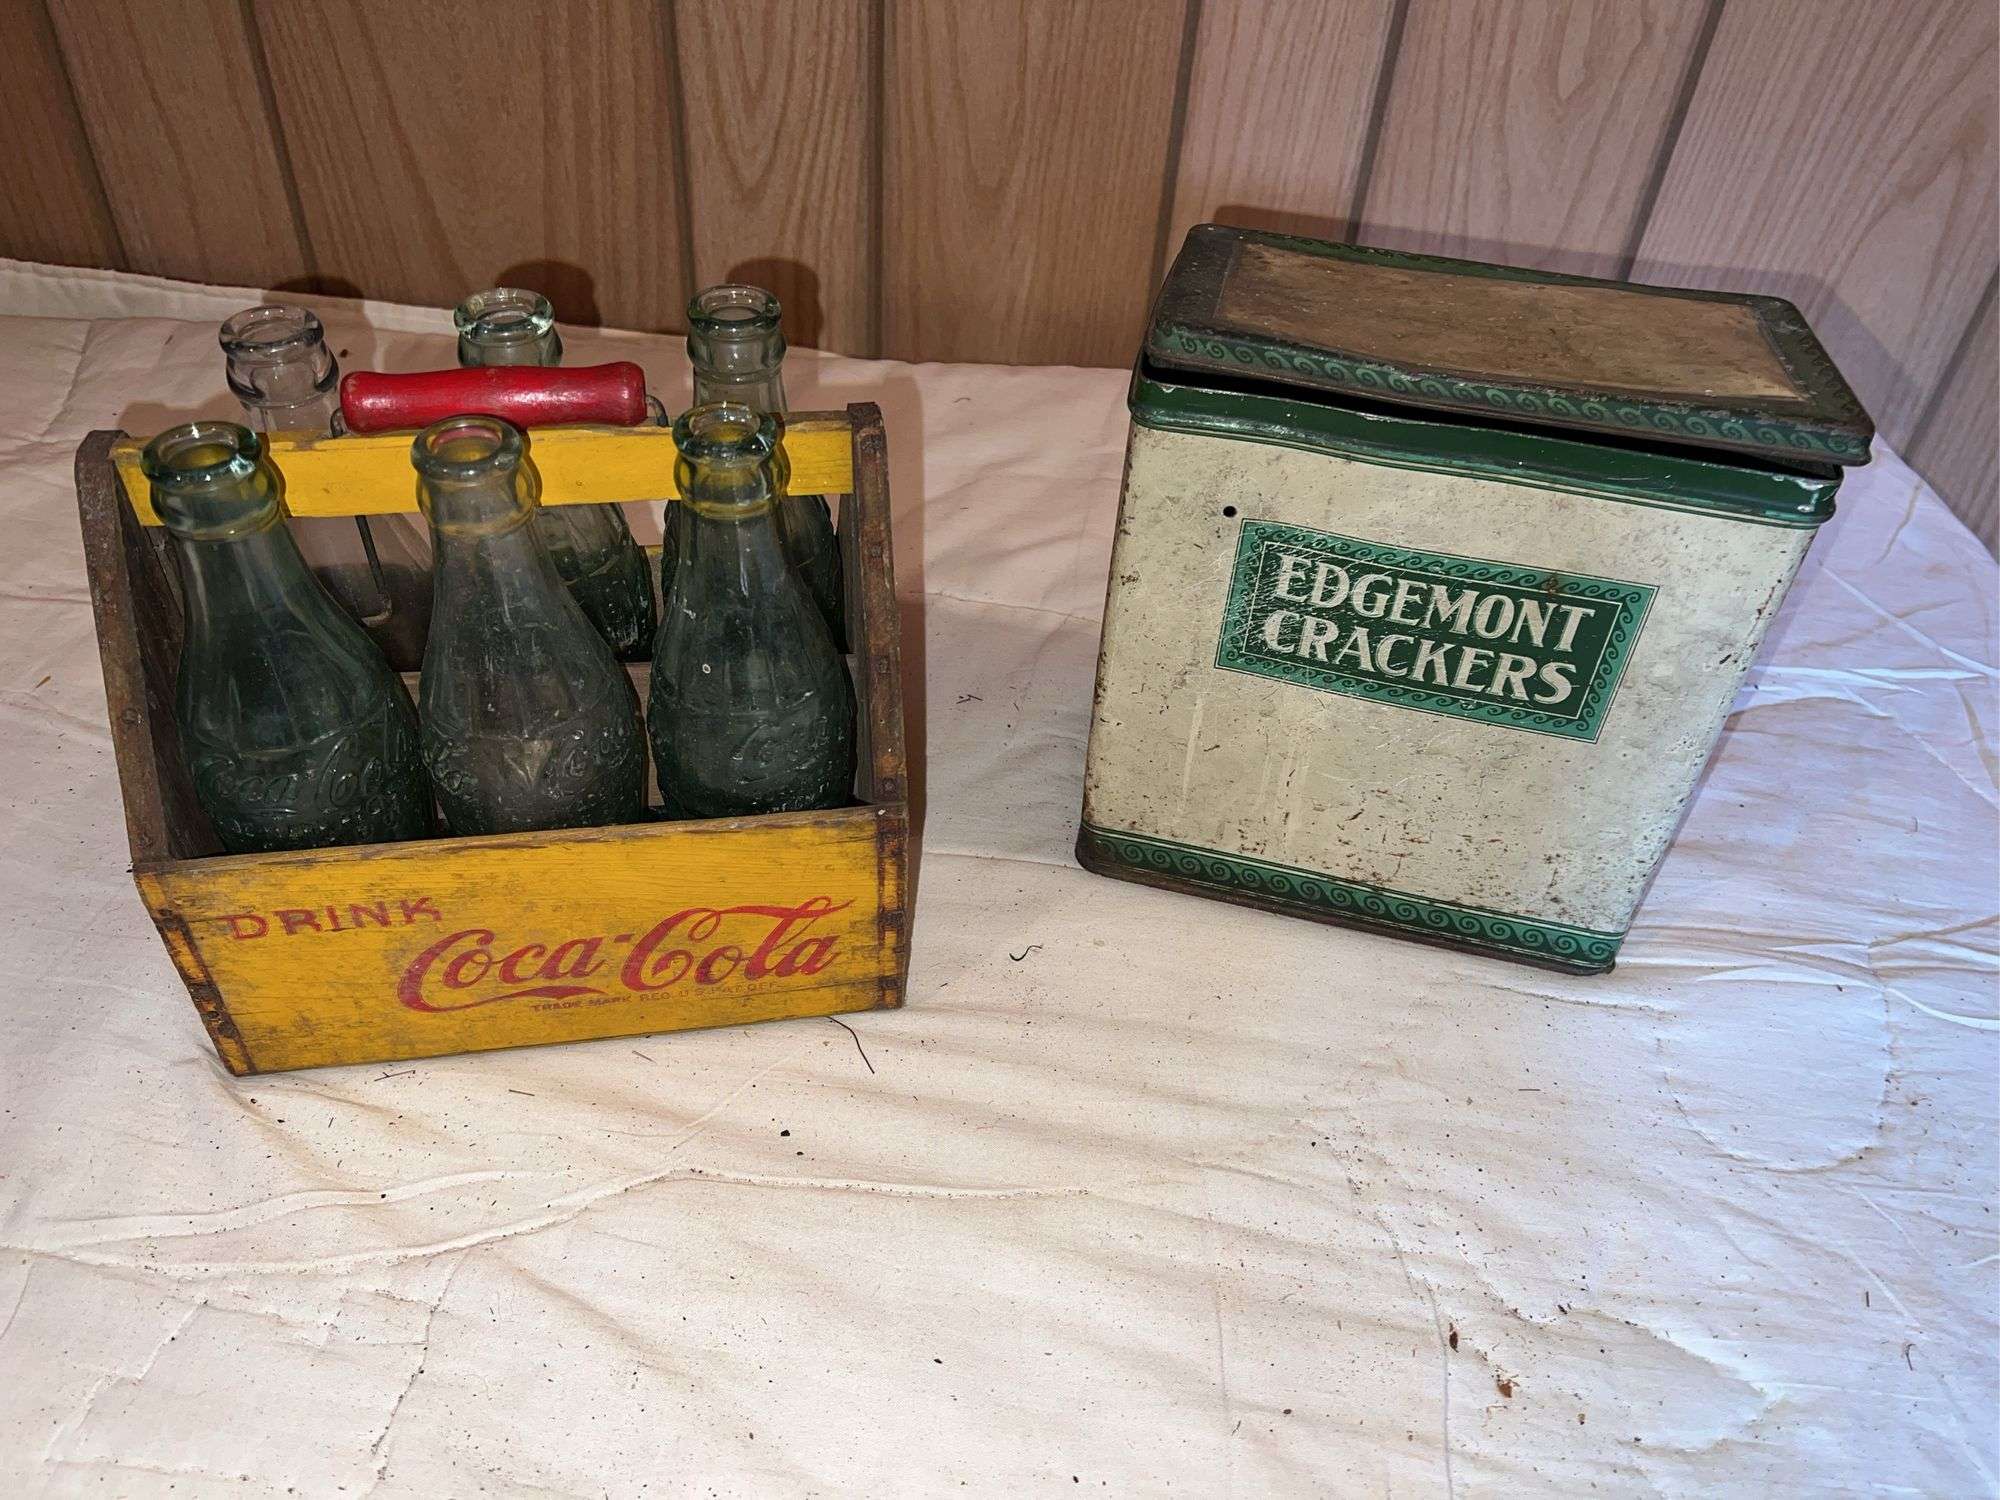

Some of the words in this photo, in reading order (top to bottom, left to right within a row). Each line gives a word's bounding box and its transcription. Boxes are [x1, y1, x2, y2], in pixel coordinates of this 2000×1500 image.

[1274, 554, 1595, 653] EDGEMONT
[1264, 609, 1578, 705] CRACKERS
[216, 897, 442, 940] DRINK
[398, 896, 856, 1012] Coca-Cola
